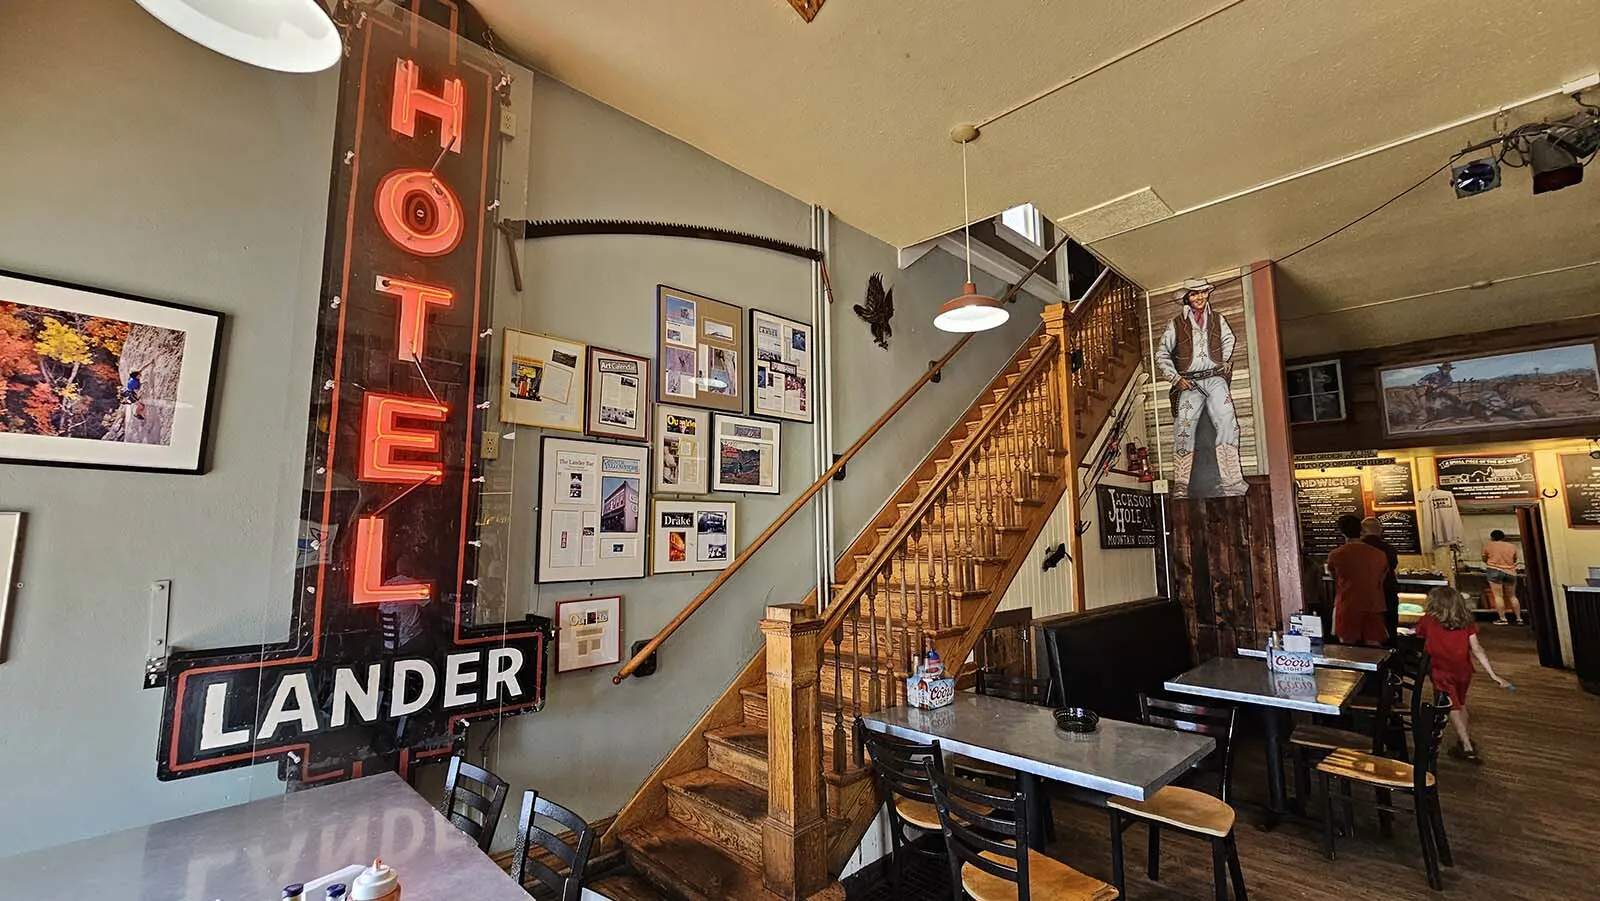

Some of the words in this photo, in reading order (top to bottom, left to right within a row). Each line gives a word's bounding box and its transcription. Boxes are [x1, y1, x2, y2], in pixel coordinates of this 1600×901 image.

[353, 57, 466, 606] HOTEL
[601, 361, 611, 370] Art
[1108, 489, 1152, 522] JACKSON
[664, 515, 691, 526] Drake
[1116, 508, 1142, 533] HOLE
[1276, 655, 1310, 667] Coors
[199, 647, 524, 751] LANDER
[930, 686, 953, 701] Coors
